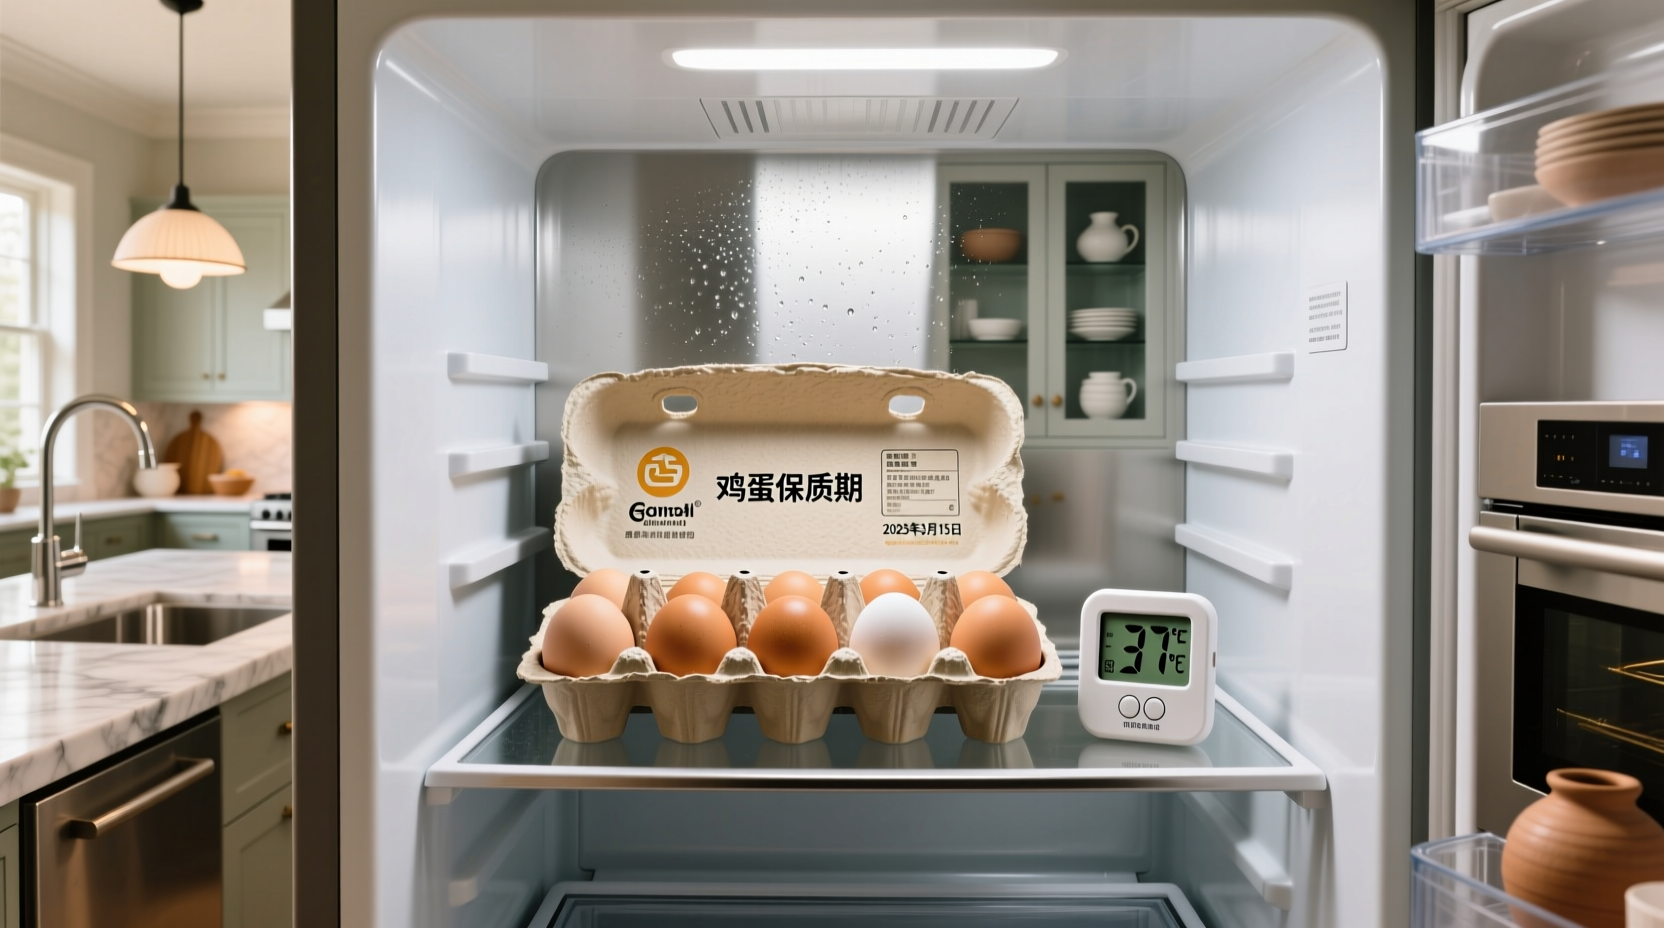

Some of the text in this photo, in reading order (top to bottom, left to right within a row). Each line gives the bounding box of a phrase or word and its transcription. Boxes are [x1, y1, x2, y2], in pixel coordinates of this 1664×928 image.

[716, 472, 863, 503] 鸡蛋保质期
[1120, 624, 1170, 675] 37
